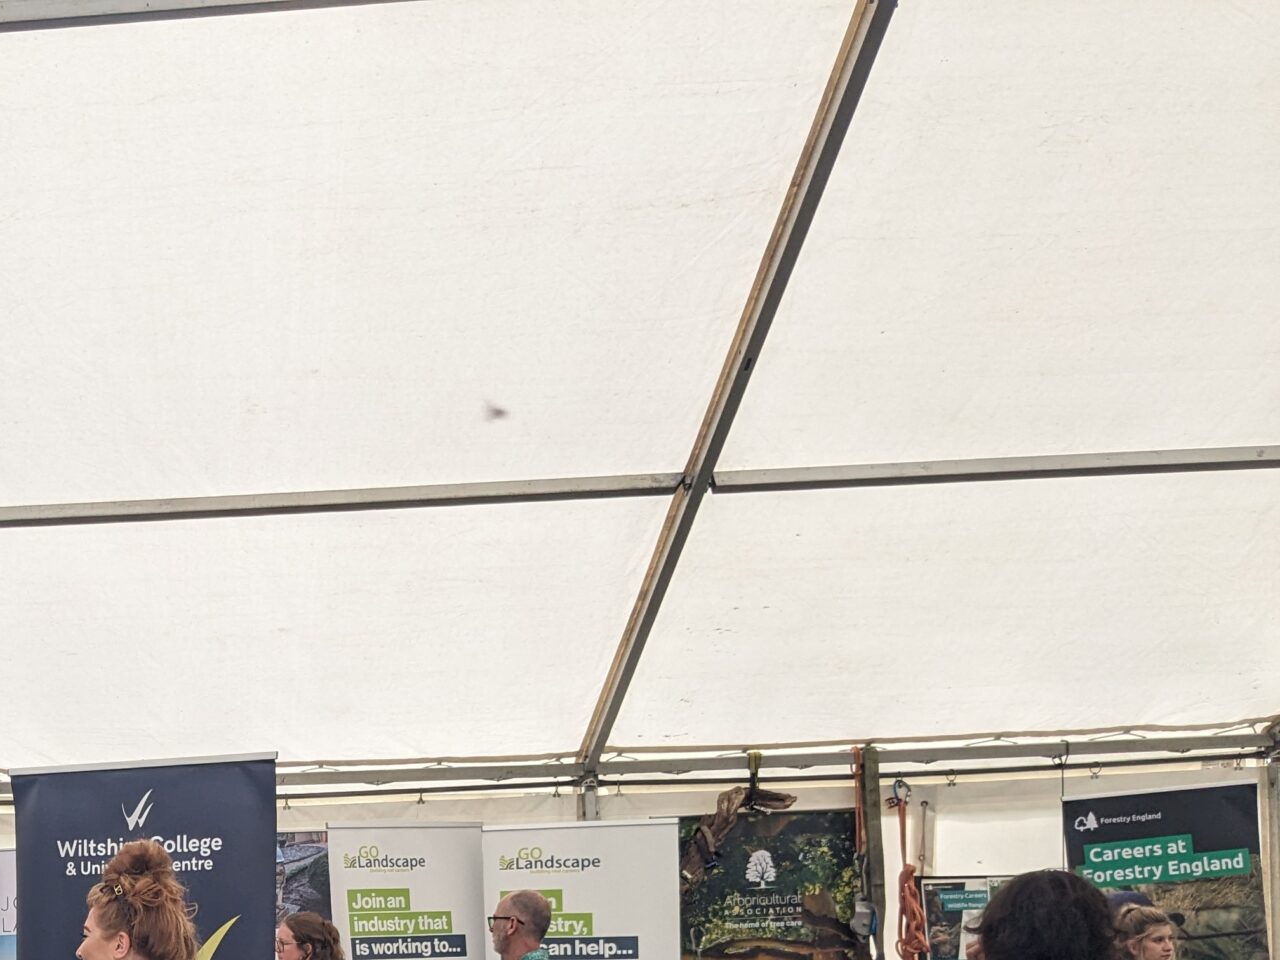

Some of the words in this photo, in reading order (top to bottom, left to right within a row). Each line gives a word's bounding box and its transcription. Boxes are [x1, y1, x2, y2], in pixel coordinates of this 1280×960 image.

[1100, 815, 1131, 824] Forestry
[1132, 812, 1162, 822] England
[359, 845, 379, 859] GO
[518, 847, 542, 860] GO
[1089, 843, 1163, 863] Careers
[1168, 839, 1187, 854] at
[66, 862, 77, 876] &
[172, 857, 214, 871] entre
[357, 854, 426, 871] Landscape
[516, 855, 600, 871] Landscape
[1083, 864, 1163, 883] Forestry
[1168, 852, 1244, 877] England
[352, 893, 385, 909] Join
[387, 896, 405, 908] an
[354, 916, 415, 934] industry
[418, 915, 448, 930] that
[355, 940, 369, 956] is
[371, 938, 432, 957] working
[434, 938, 461, 953] to...
[575, 940, 633, 958] help...
